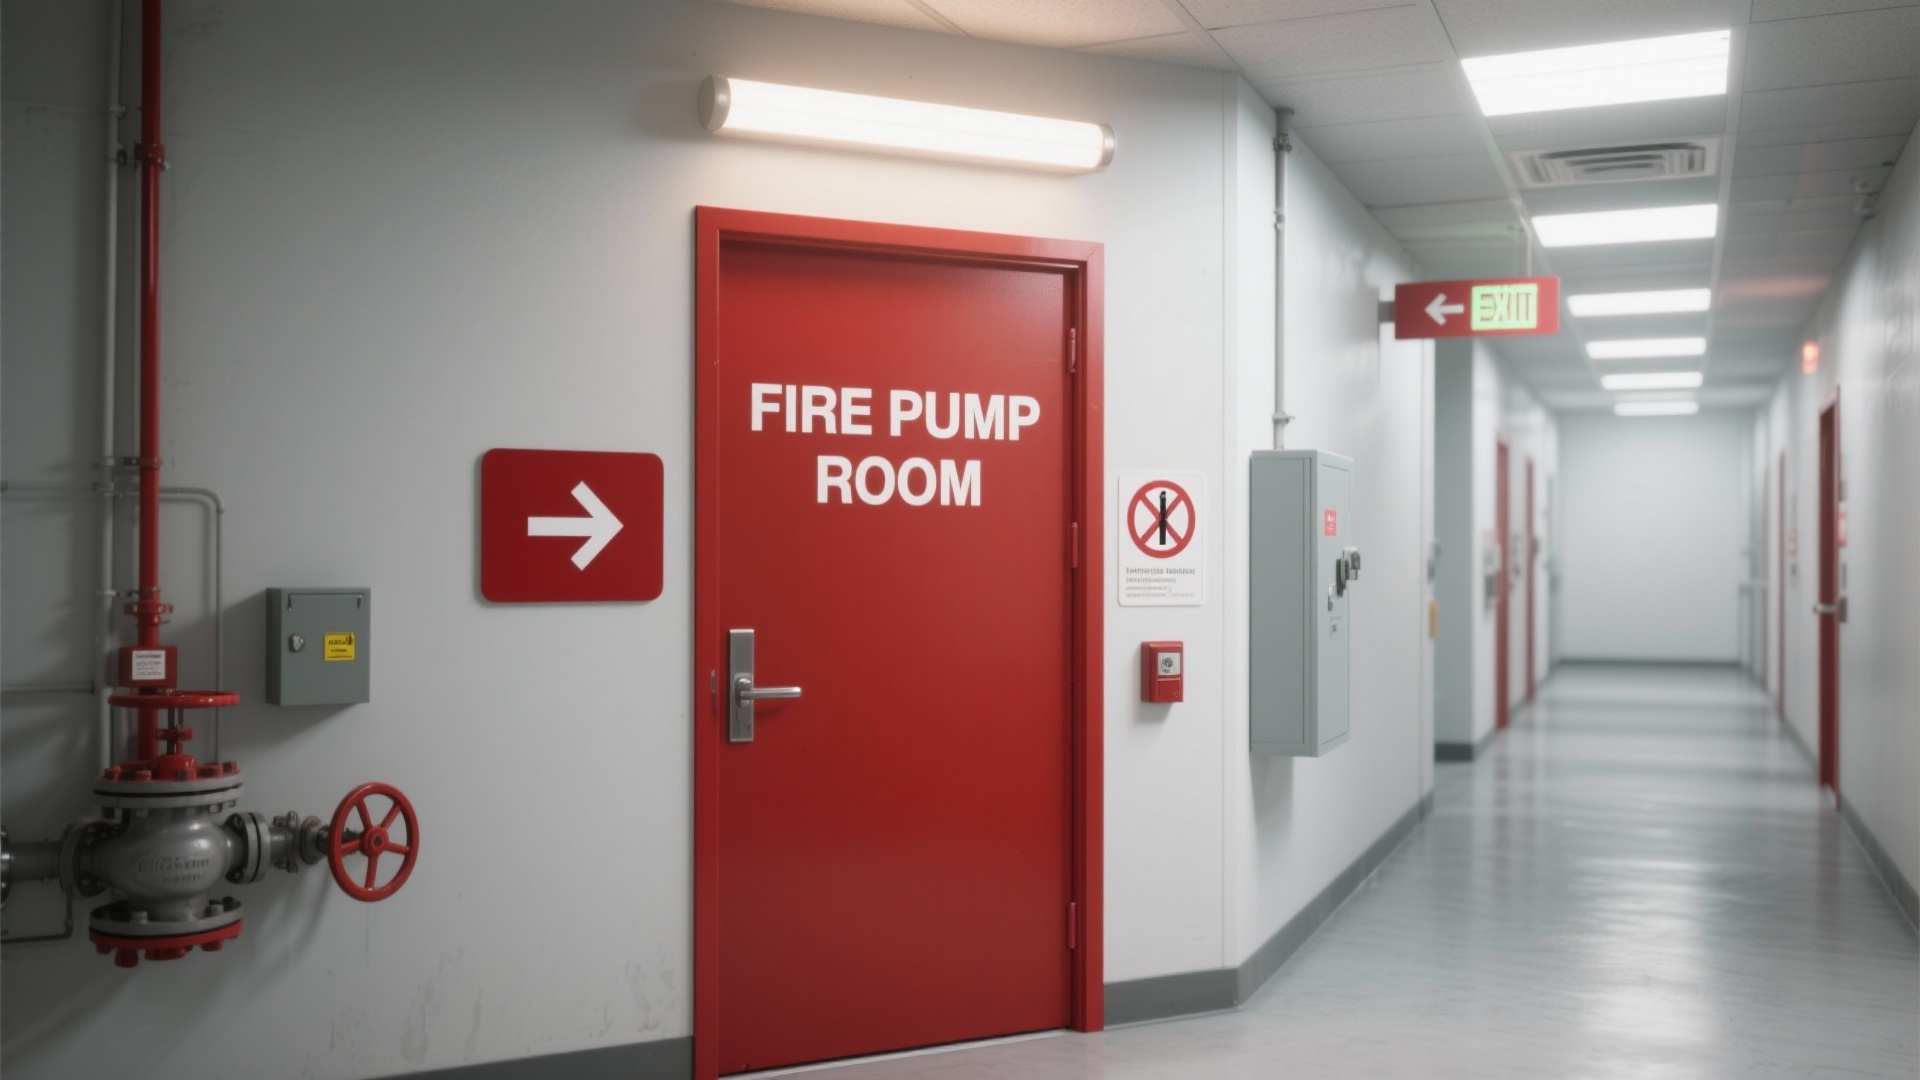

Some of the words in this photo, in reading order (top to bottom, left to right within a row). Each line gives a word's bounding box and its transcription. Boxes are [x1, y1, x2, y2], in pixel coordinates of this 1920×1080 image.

[750, 382, 873, 436] FIRE
[889, 389, 1041, 441] PUMP
[816, 454, 982, 507] ROOM
